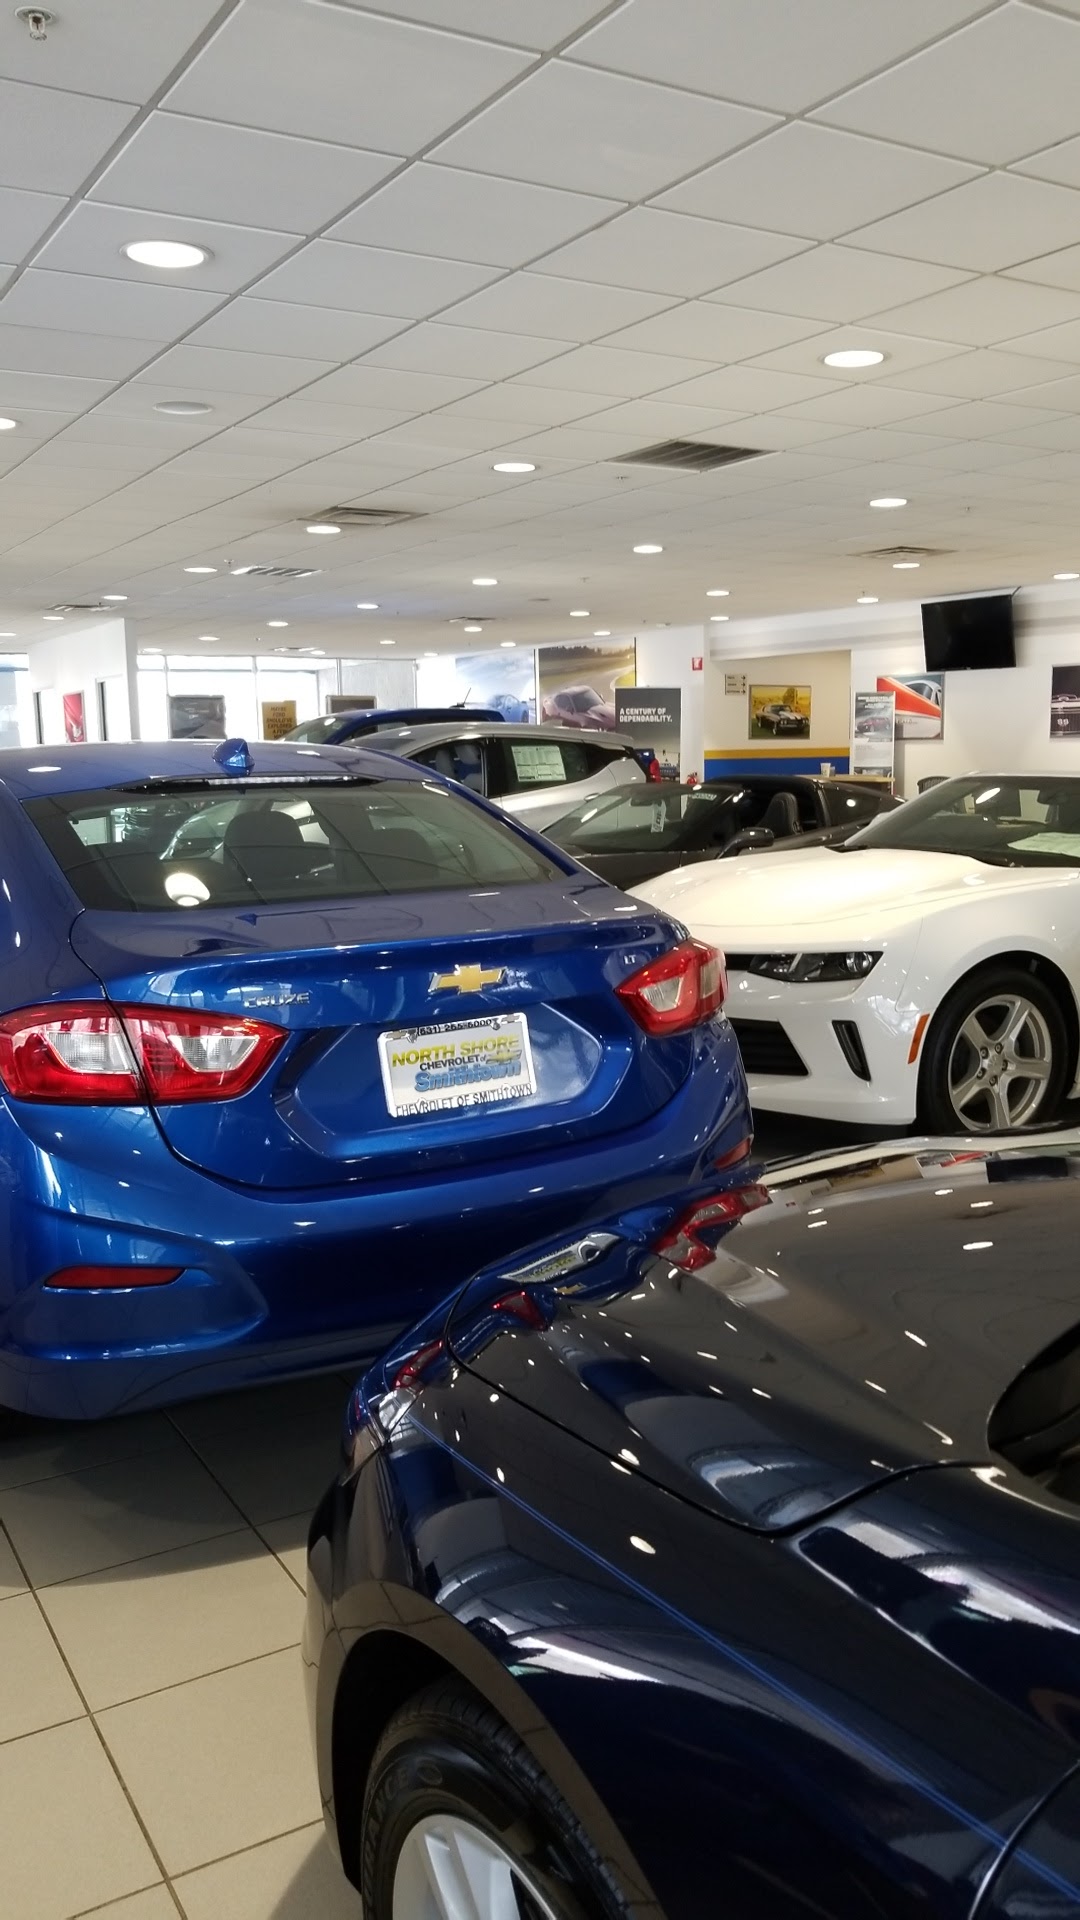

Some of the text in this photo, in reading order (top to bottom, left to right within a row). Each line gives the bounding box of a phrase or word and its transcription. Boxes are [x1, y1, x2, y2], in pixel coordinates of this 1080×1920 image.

[619, 715, 673, 723] DEPENDABILITY.
[625, 707, 657, 715] CENTURY
[657, 707, 667, 715] OF
[623, 954, 636, 965] LT
[243, 992, 310, 1009] CRUZE
[392, 1034, 520, 1067] NORTH SHORE
[419, 1054, 487, 1071] CHEVROLET of
[414, 1060, 522, 1092] Smithtown
[395, 1083, 533, 1116] CHEVROLET OF SMITHTOWN
